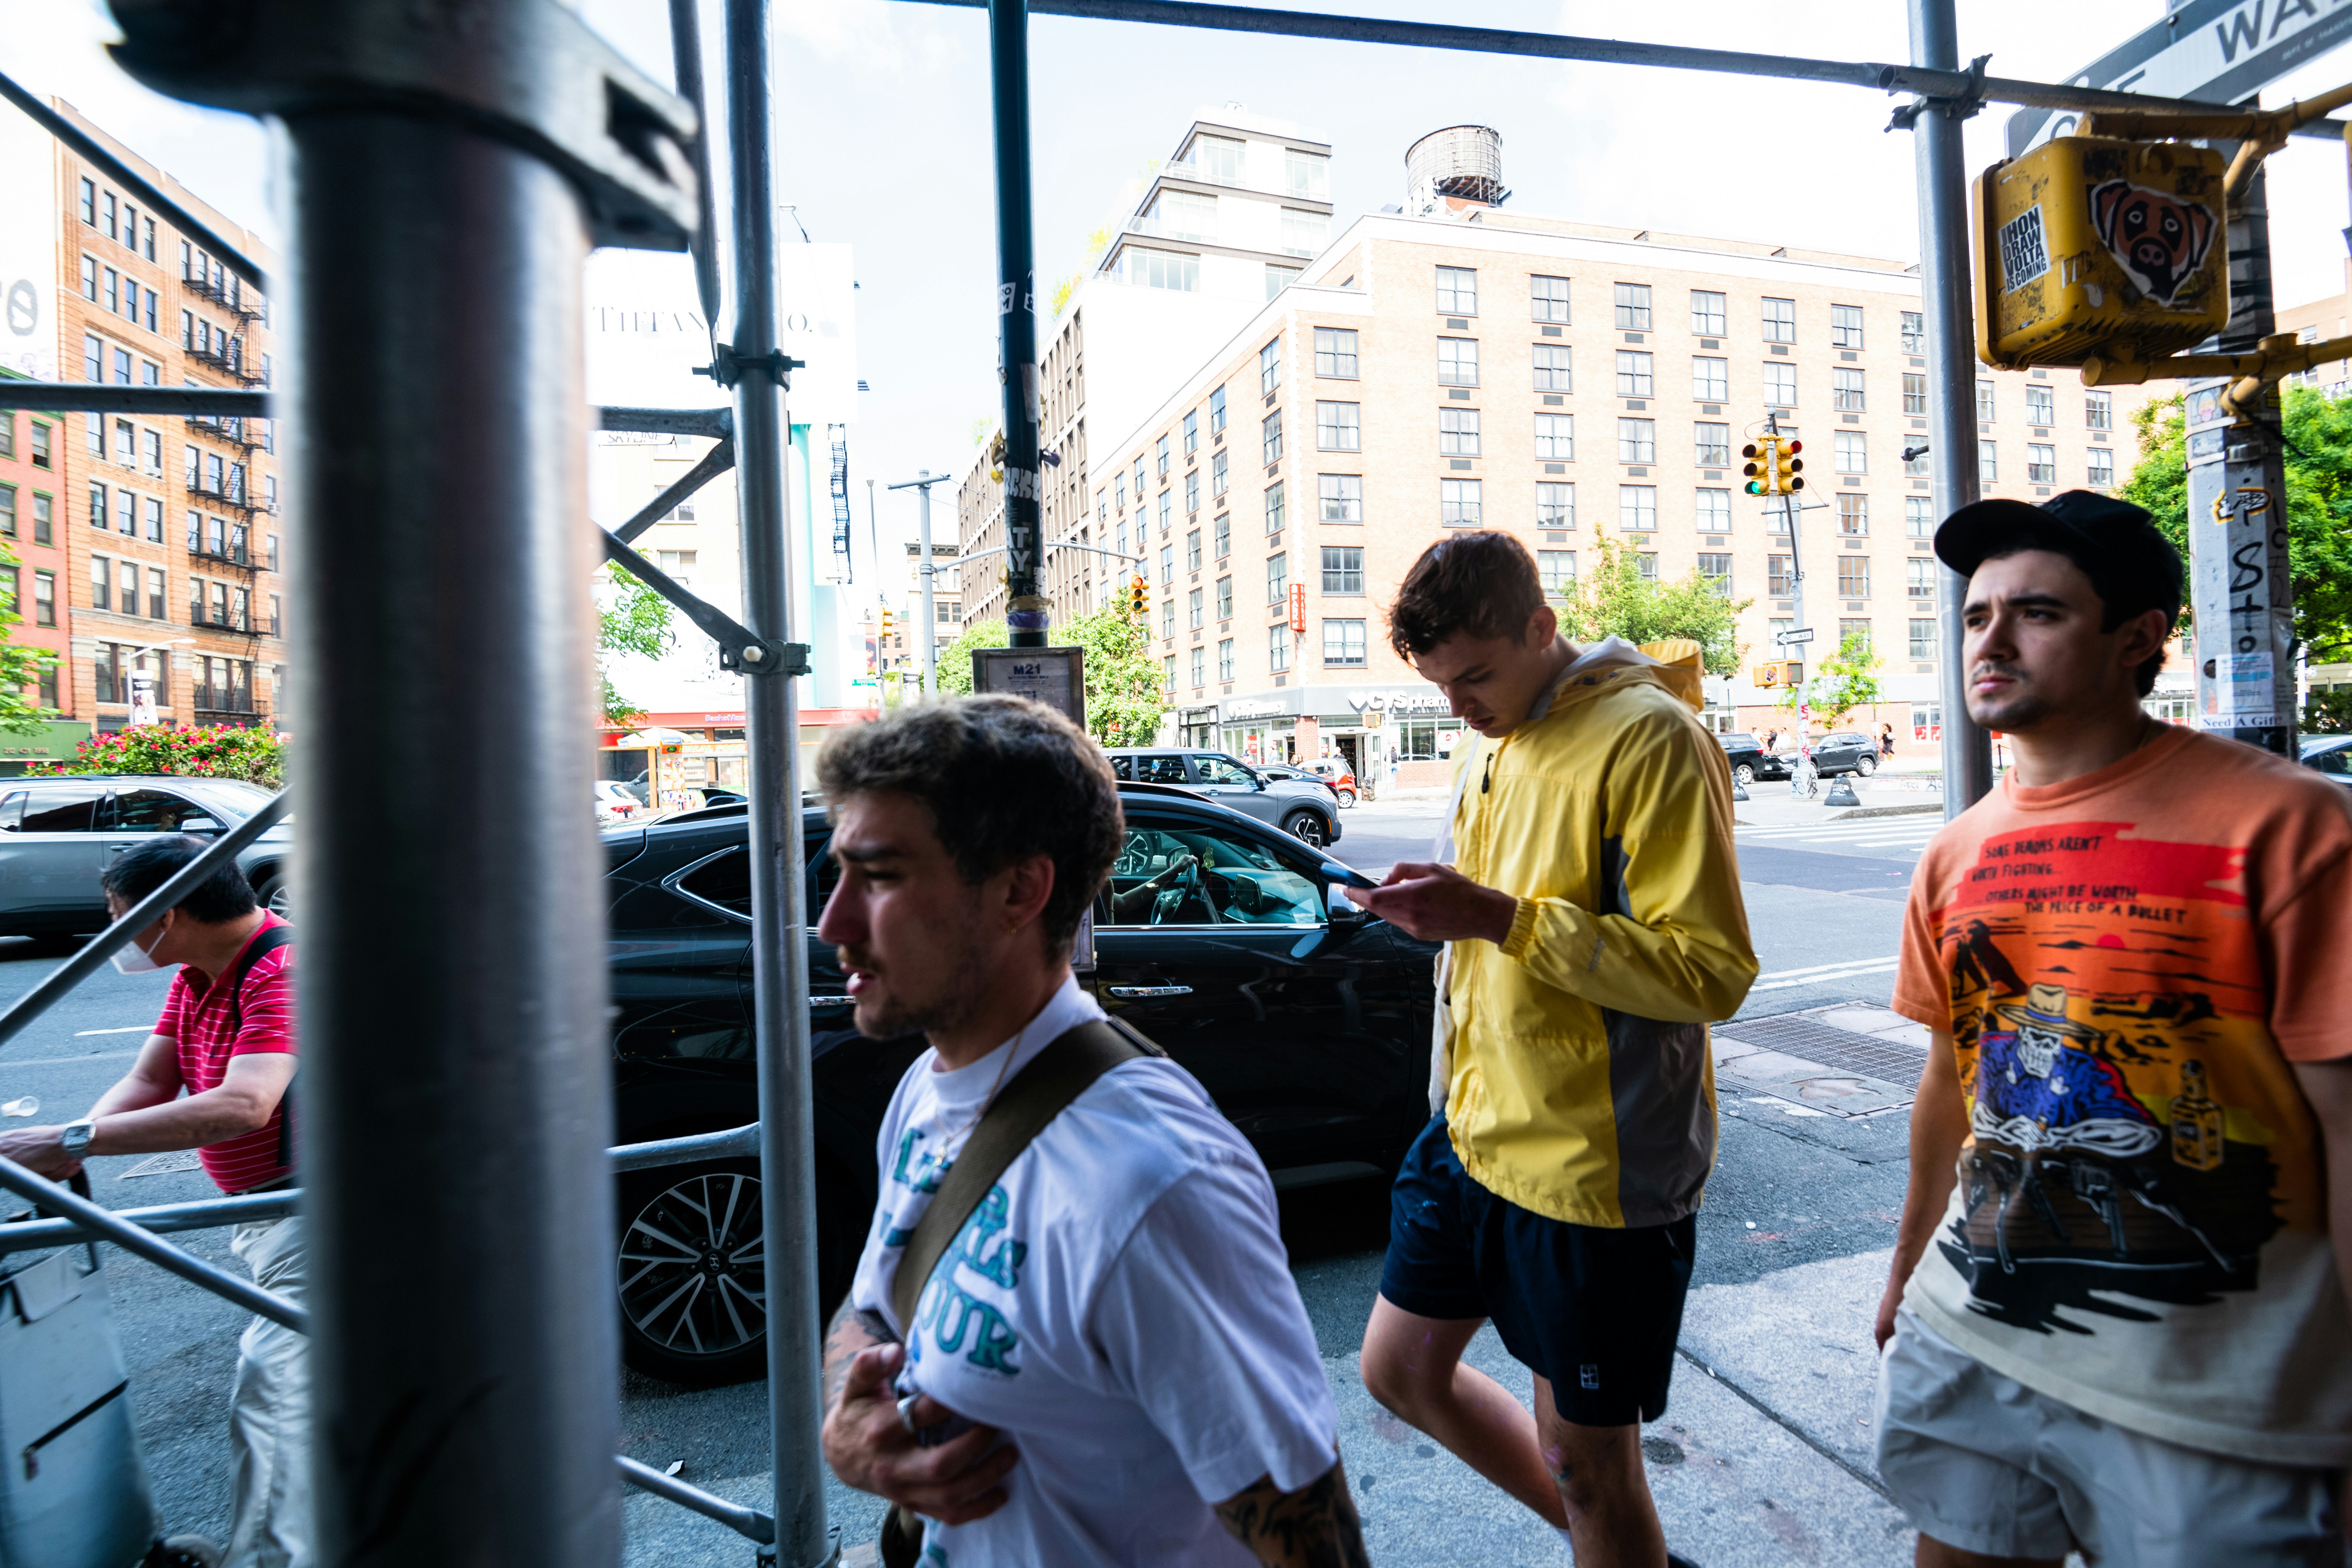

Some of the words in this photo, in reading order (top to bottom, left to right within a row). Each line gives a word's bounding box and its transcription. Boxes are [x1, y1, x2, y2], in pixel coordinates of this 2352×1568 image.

[2216, 0, 2340, 64] WA
[2000, 207, 2040, 247] JHON
[2002, 226, 2041, 263] DRAW
[2005, 242, 2044, 277] VOLTA
[2006, 276, 2015, 292] IS
[2015, 257, 2047, 286] COMING
[1013, 664, 1040, 675] M21
[1368, 690, 1408, 709] CVS
[2203, 718, 2230, 727] Need
[2235, 717, 2246, 726] A
[2110, 904, 2121, 916] A
